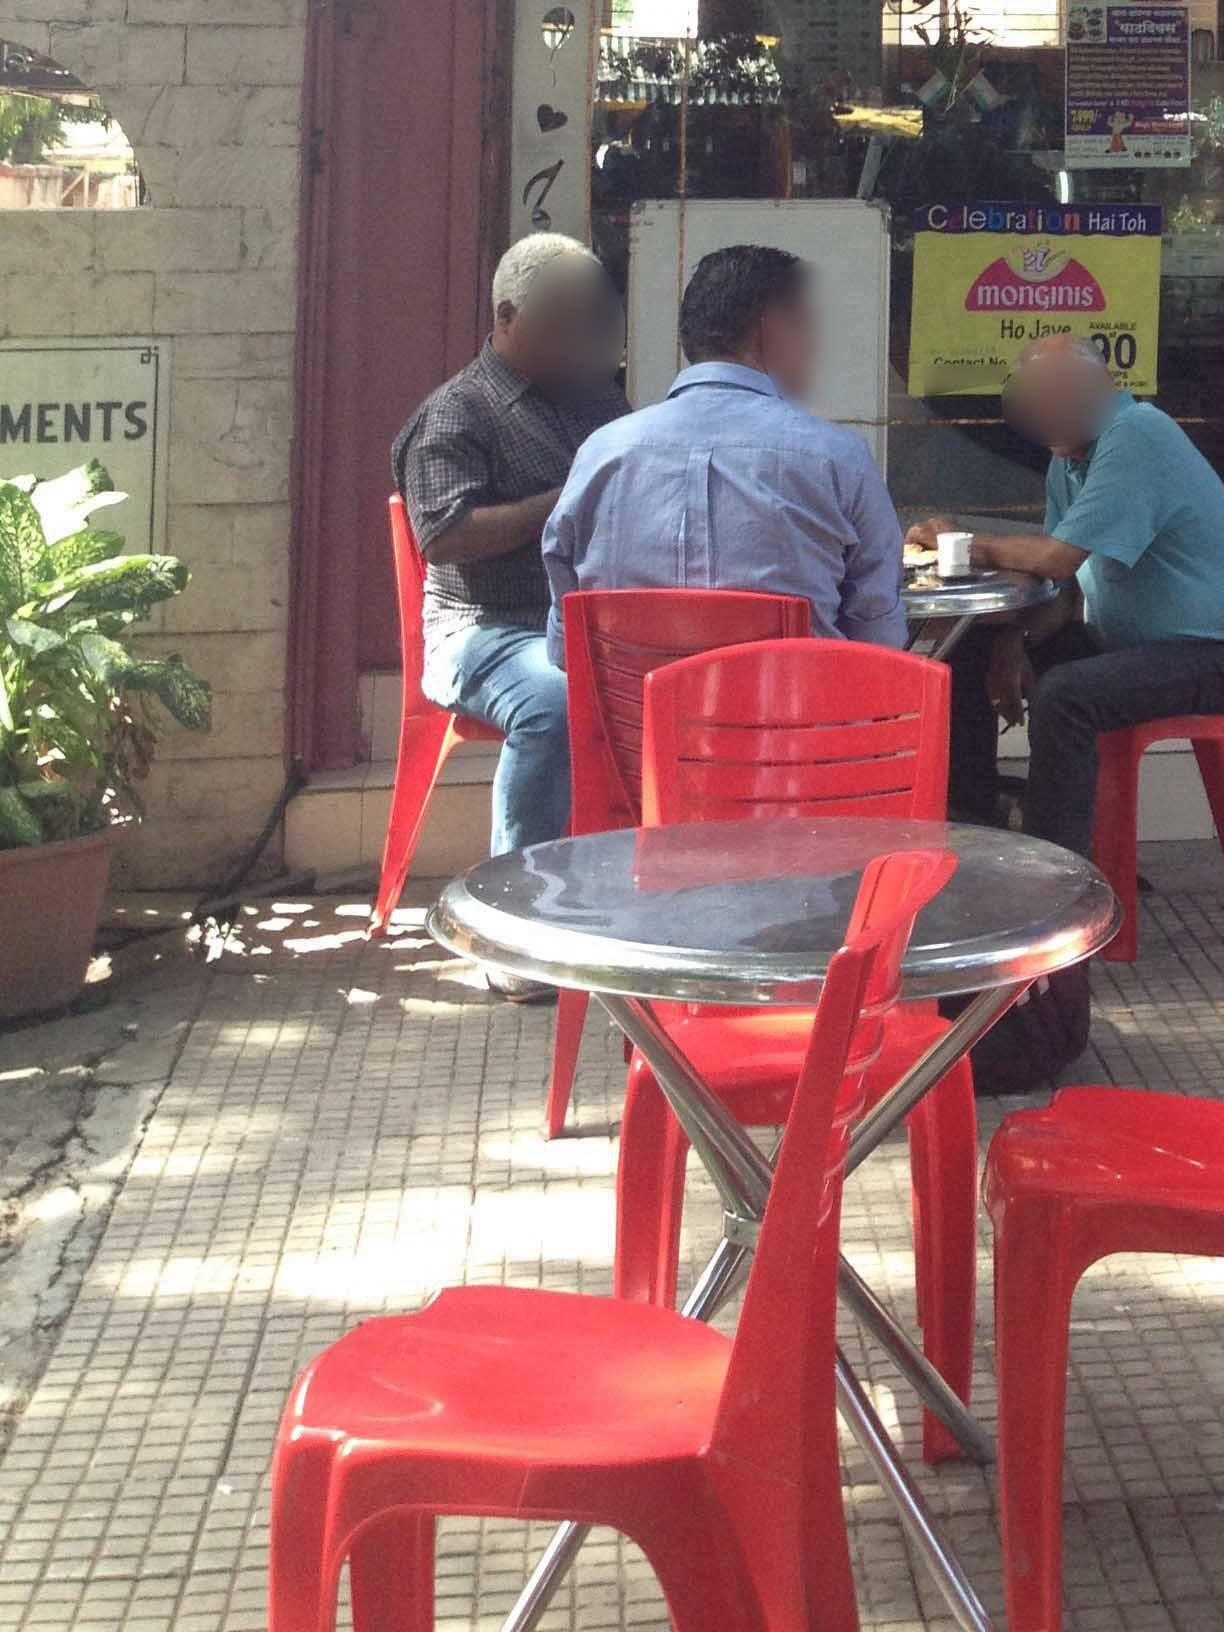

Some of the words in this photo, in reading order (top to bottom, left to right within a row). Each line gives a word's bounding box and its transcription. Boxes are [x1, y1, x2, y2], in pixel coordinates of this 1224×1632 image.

[928, 205, 1079, 230] Celebration
[1088, 212, 1115, 231] Hai
[1120, 213, 1146, 232] Toh
[1000, 320, 1024, 339] Ho
[0, 401, 147, 443] MENTS
